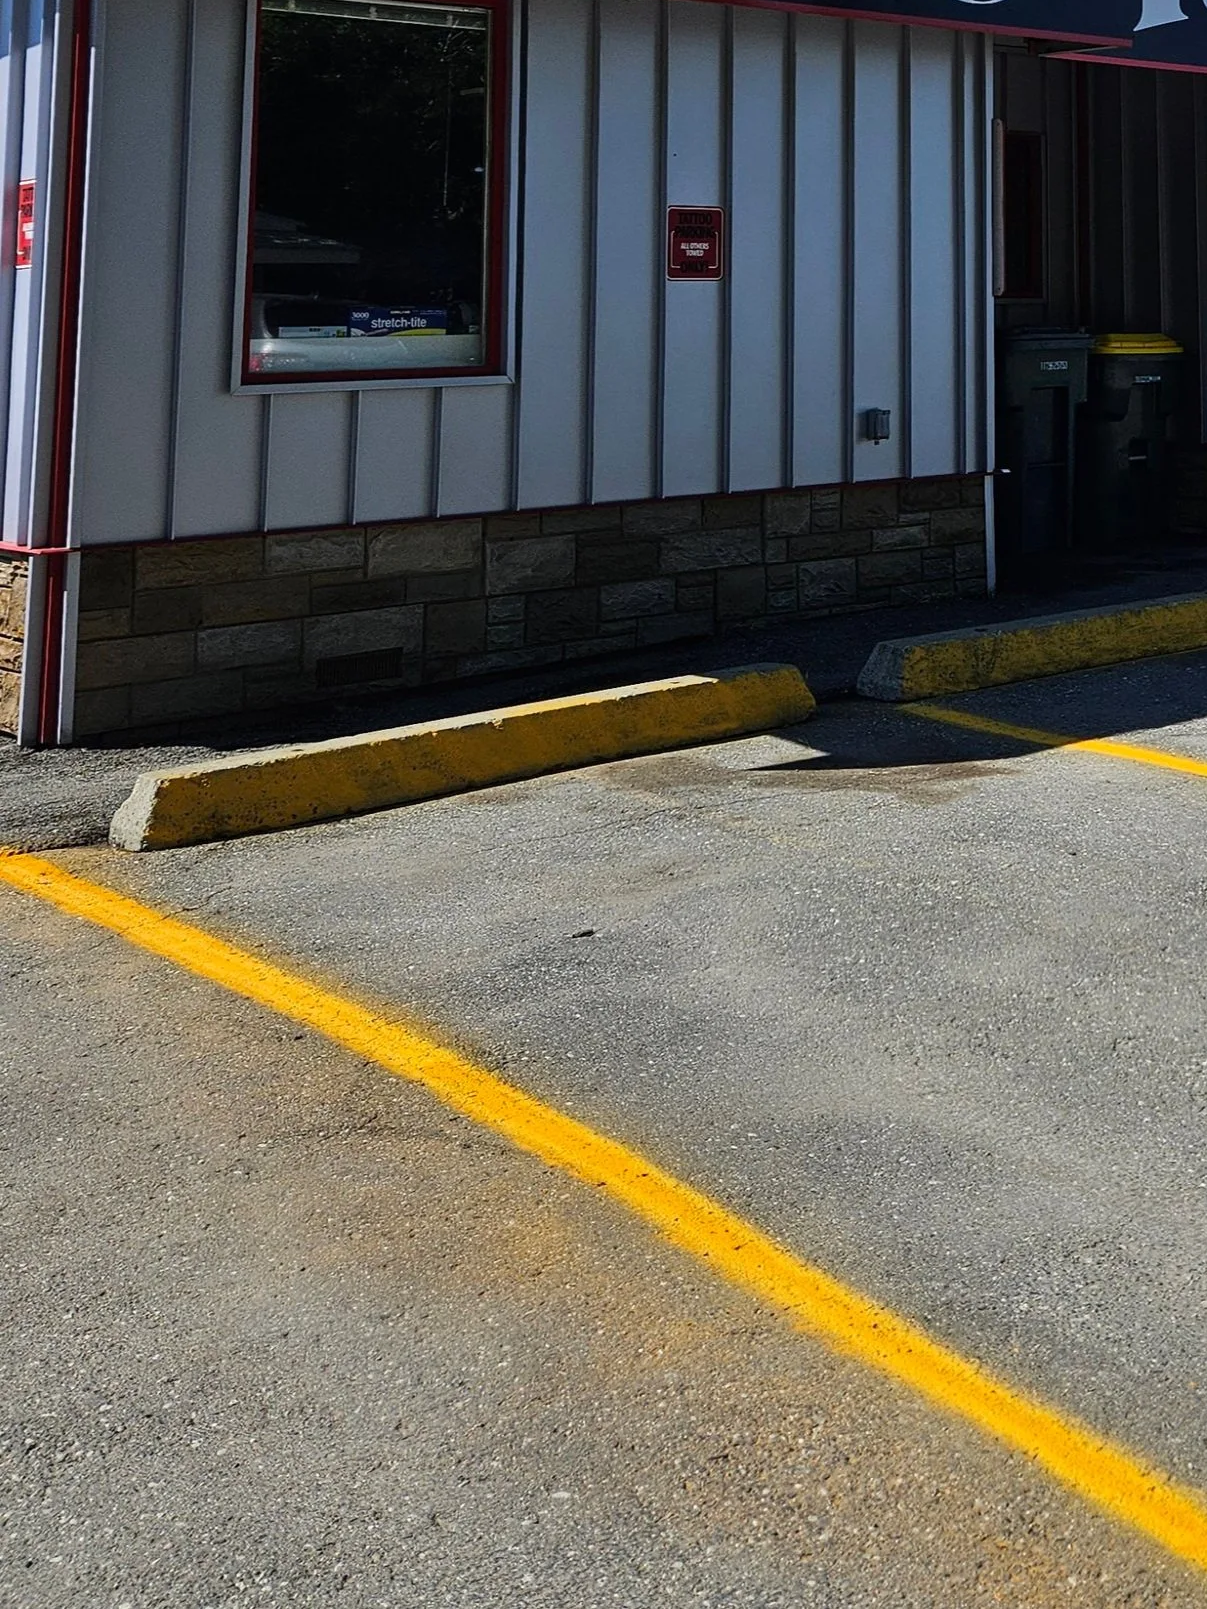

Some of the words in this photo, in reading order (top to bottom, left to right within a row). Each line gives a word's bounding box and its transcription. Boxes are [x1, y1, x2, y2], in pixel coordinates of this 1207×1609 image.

[678, 212, 713, 225] TATTOO
[675, 225, 716, 239] PARKING
[370, 316, 427, 329] stretch-tite
